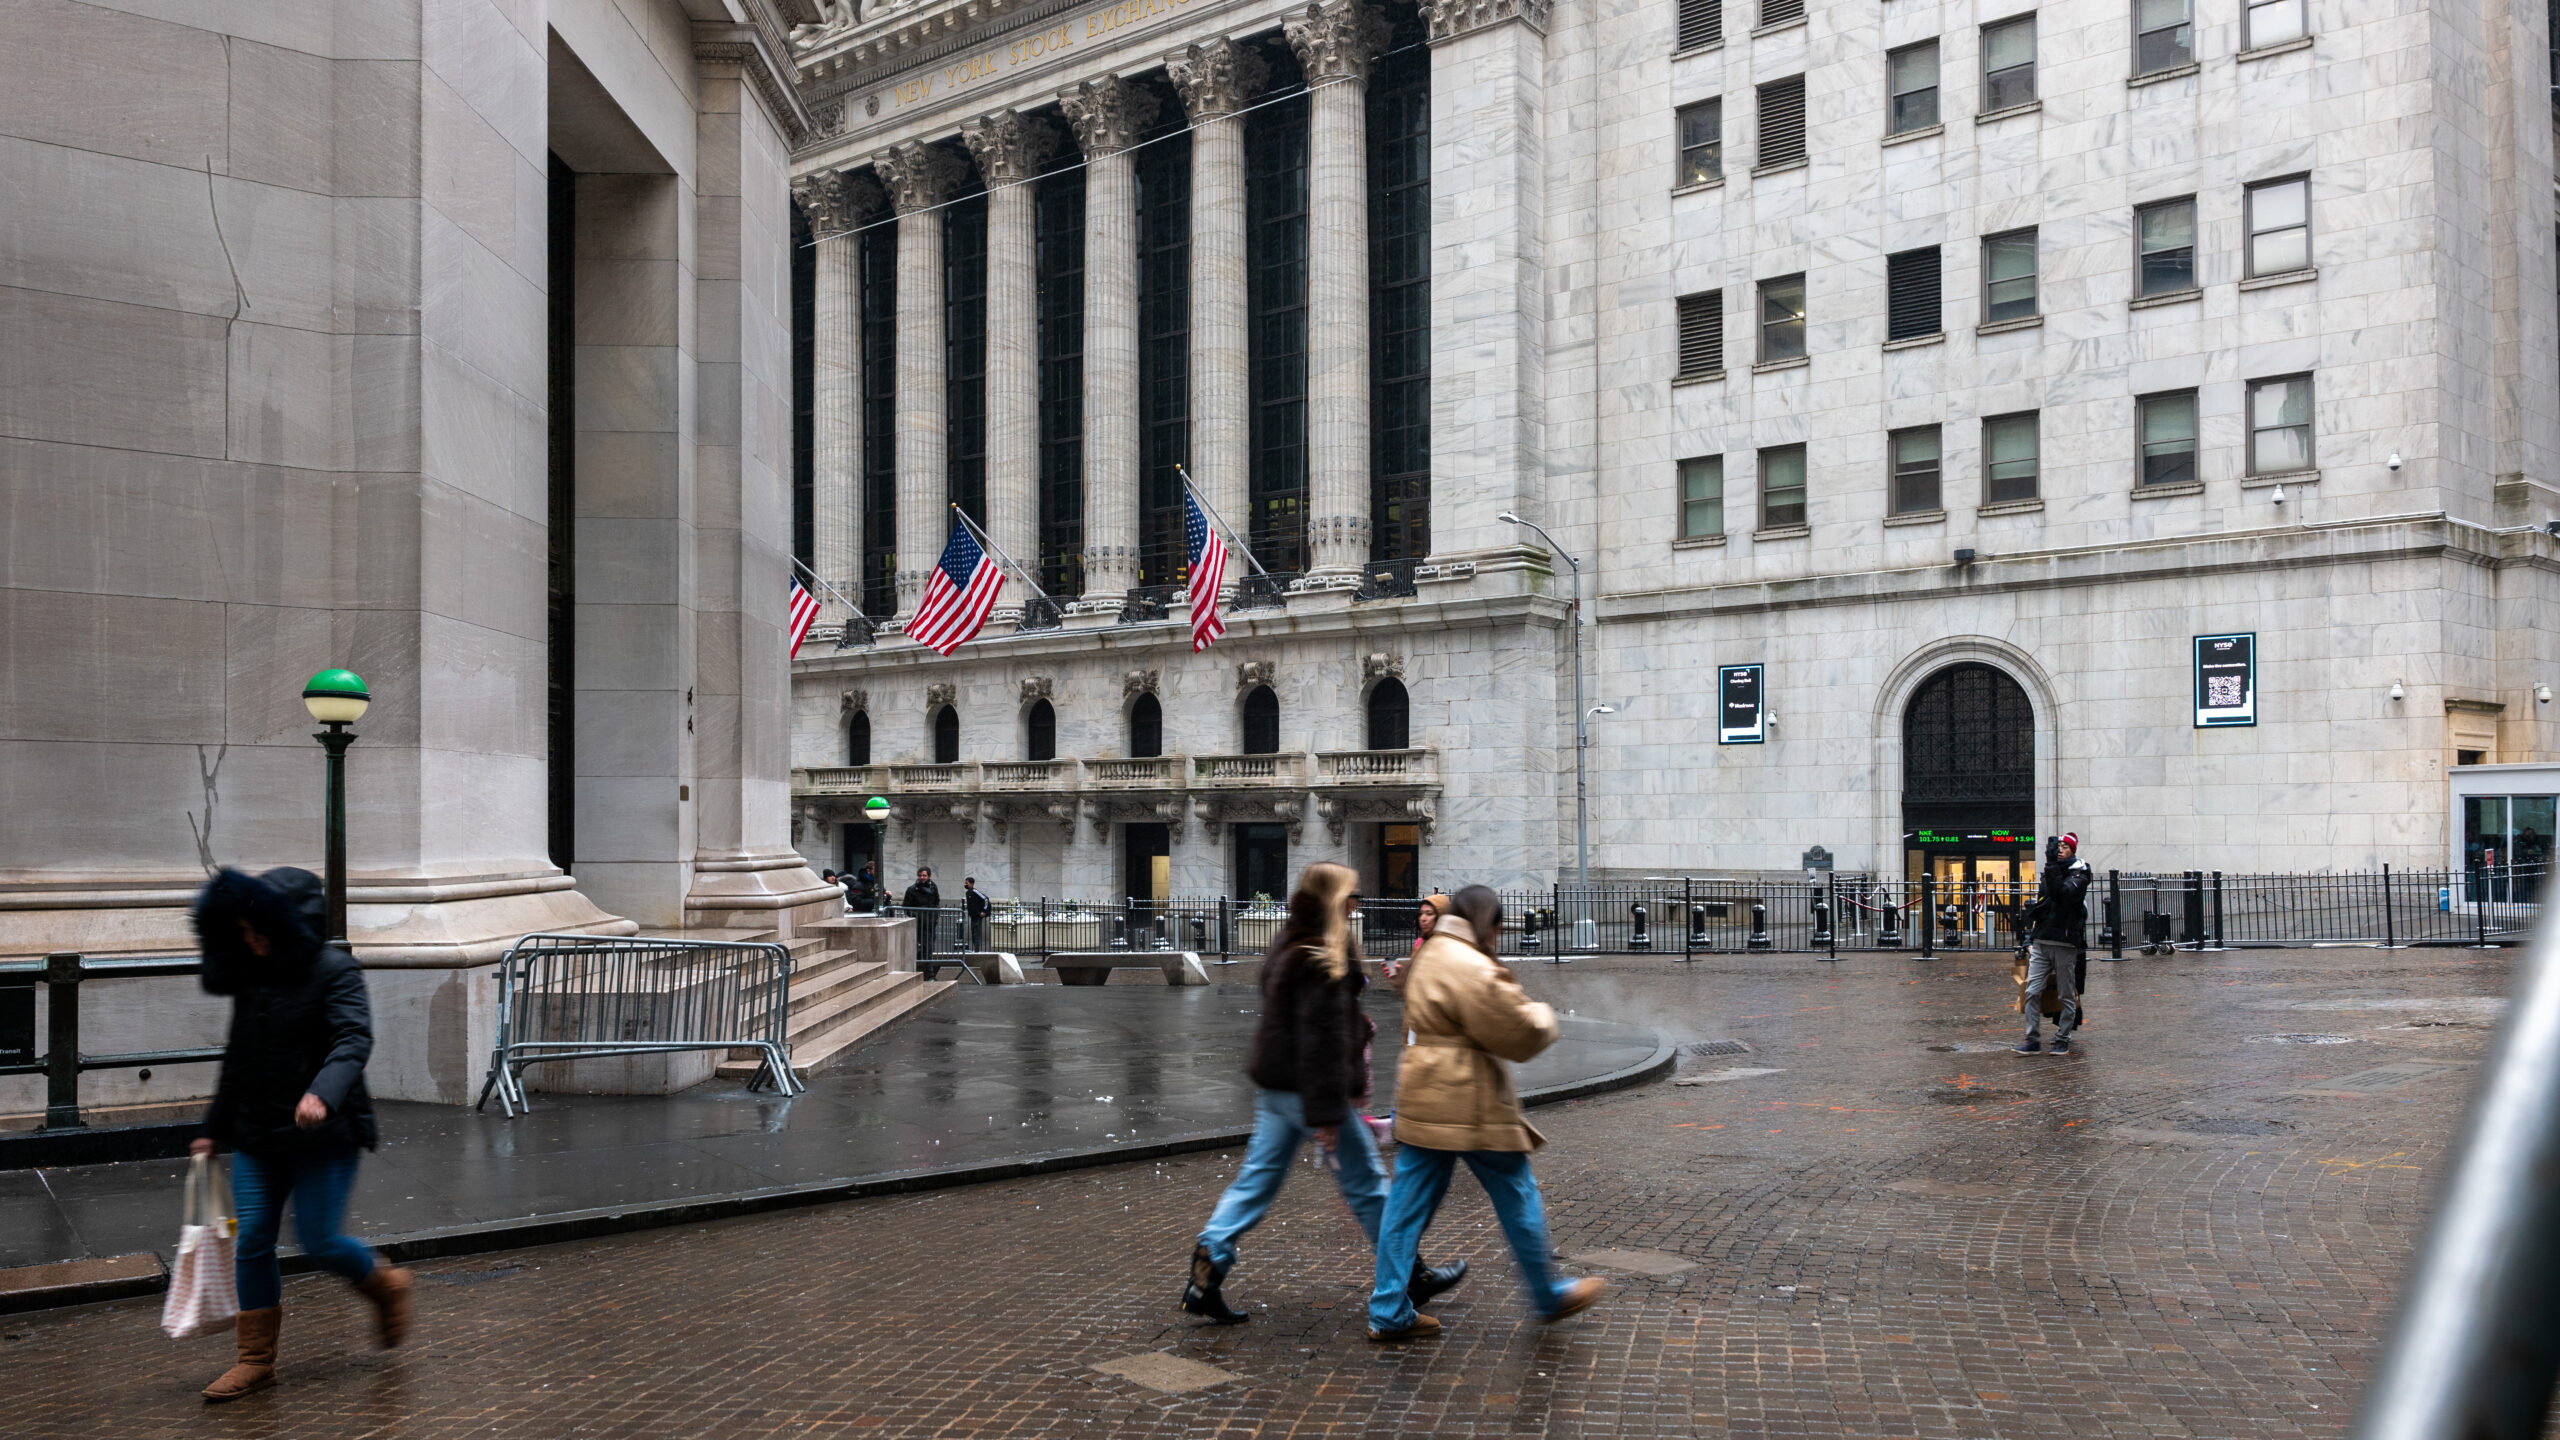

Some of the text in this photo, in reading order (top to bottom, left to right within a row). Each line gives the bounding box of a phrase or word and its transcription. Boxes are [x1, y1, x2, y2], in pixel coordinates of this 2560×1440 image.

[895, 0, 1190, 107] NEW YORK STOCK EXCHAN
